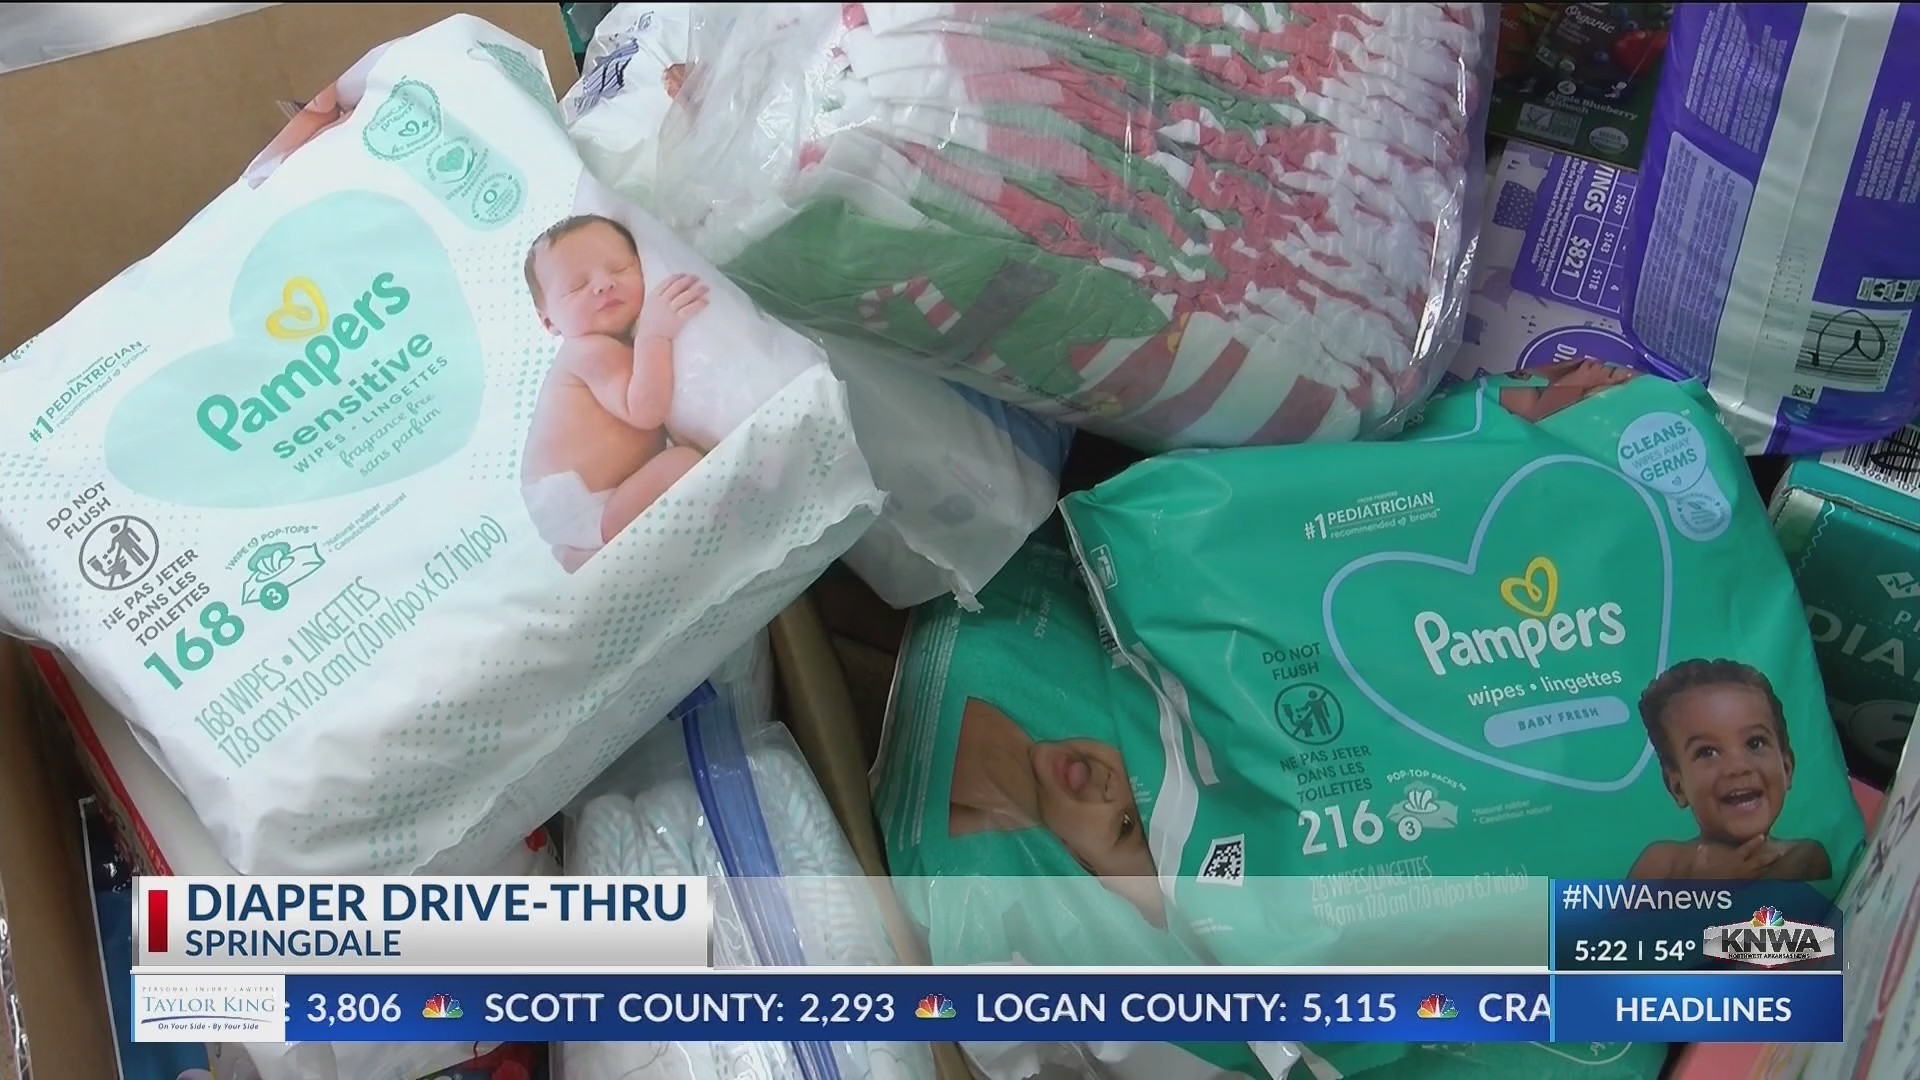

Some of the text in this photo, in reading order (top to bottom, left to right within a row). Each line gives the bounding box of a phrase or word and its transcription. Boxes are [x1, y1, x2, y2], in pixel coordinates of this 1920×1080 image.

[1613, 194, 1627, 216] $247
[1562, 235, 1592, 279] $821
[1600, 231, 1615, 254] $143
[196, 272, 411, 452] Pampers
[29, 415, 53, 442] #1
[46, 341, 142, 419] PEDIATRICIAN
[272, 333, 433, 459] sensitive
[294, 356, 448, 472] WIPES LINGETTES
[339, 392, 435, 468] fragrance free
[360, 407, 441, 477] sans parfum
[1632, 438, 1690, 469] WIPES AWAY
[1640, 448, 1698, 482] GERMS
[46, 482, 105, 531] DO NOT
[64, 497, 111, 539] FLUSH
[1304, 512, 1327, 540] #1
[1326, 491, 1435, 526] PEDIATRICIAN
[102, 549, 199, 630] NE PAS JETER
[126, 571, 197, 632] DANS LES
[267, 587, 282, 603] 3
[135, 582, 210, 647] TOILETTES
[1414, 602, 1626, 676] Pampers
[143, 601, 245, 690] 168
[194, 576, 380, 742] 168 WIPES LINGETTES
[218, 515, 507, 768] 17.8 cm x 17.0 cm (7.0 in/po x 6.7 in/po)
[1262, 642, 1321, 666] DO NOT
[1805, 604, 1920, 681] DIA
[1272, 661, 1320, 681] FLUSH
[1467, 669, 1622, 707] wipes lingettes
[1518, 707, 1600, 732] BABY FRESH
[1280, 744, 1371, 773] NE PAS JETER
[1296, 761, 1365, 787] DANS LES
[1386, 769, 1429, 783] POP-TOP
[1296, 777, 1373, 804] TOILETTES
[1298, 799, 1416, 855] 216 3
